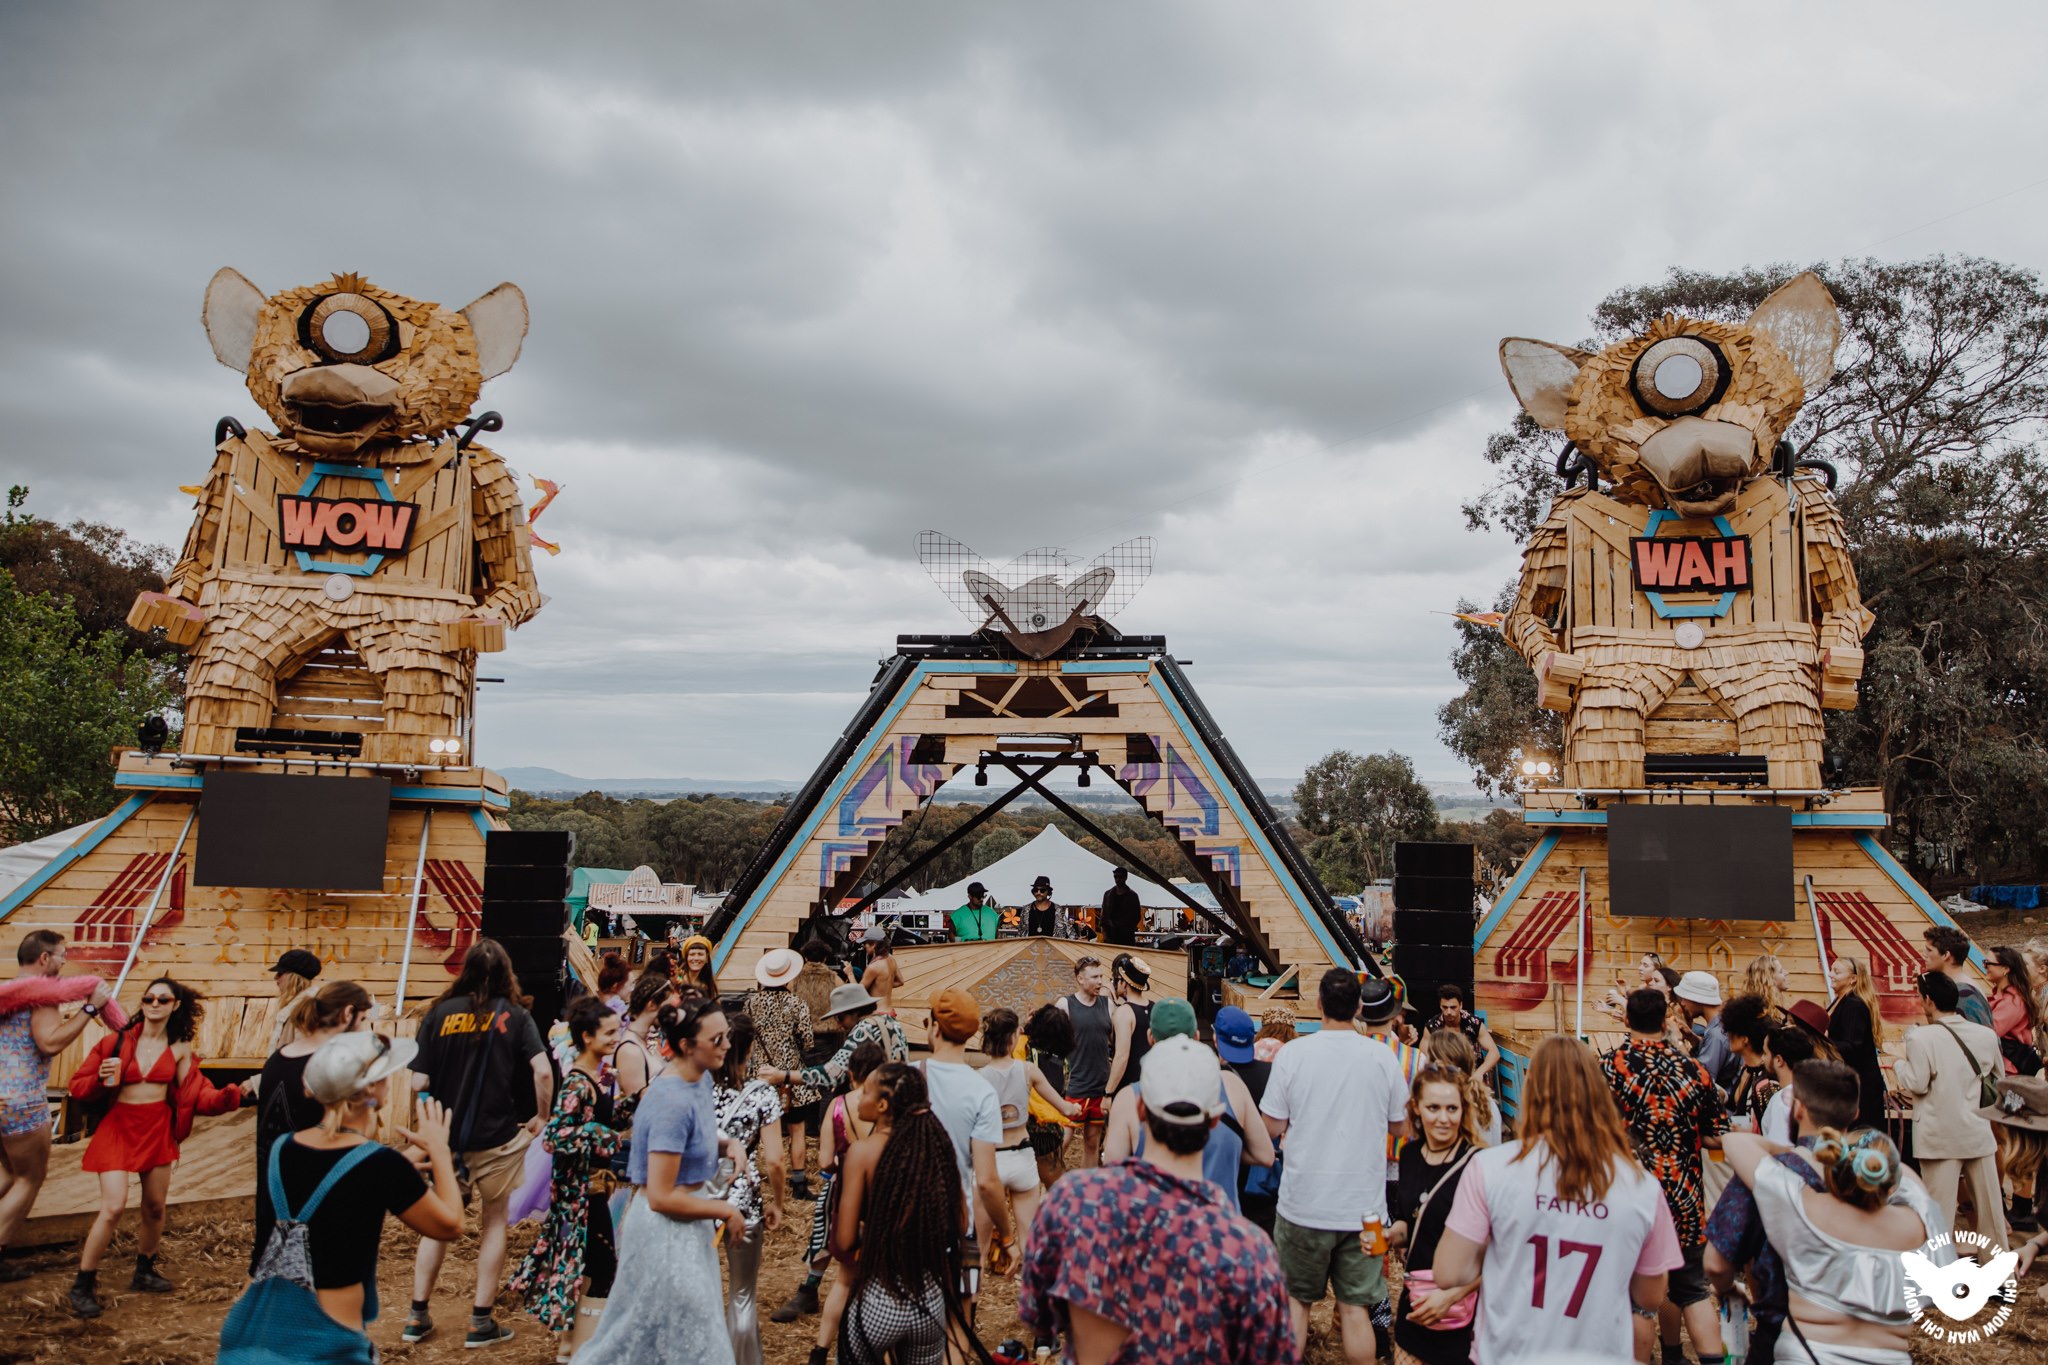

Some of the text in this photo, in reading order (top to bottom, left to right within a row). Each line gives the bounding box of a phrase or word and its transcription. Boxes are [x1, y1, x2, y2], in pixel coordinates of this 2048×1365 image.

[282, 498, 413, 549] WOW
[1636, 539, 1748, 586] WAH
[623, 886, 668, 904] PIZZA
[1526, 1233, 1603, 1319] 17
